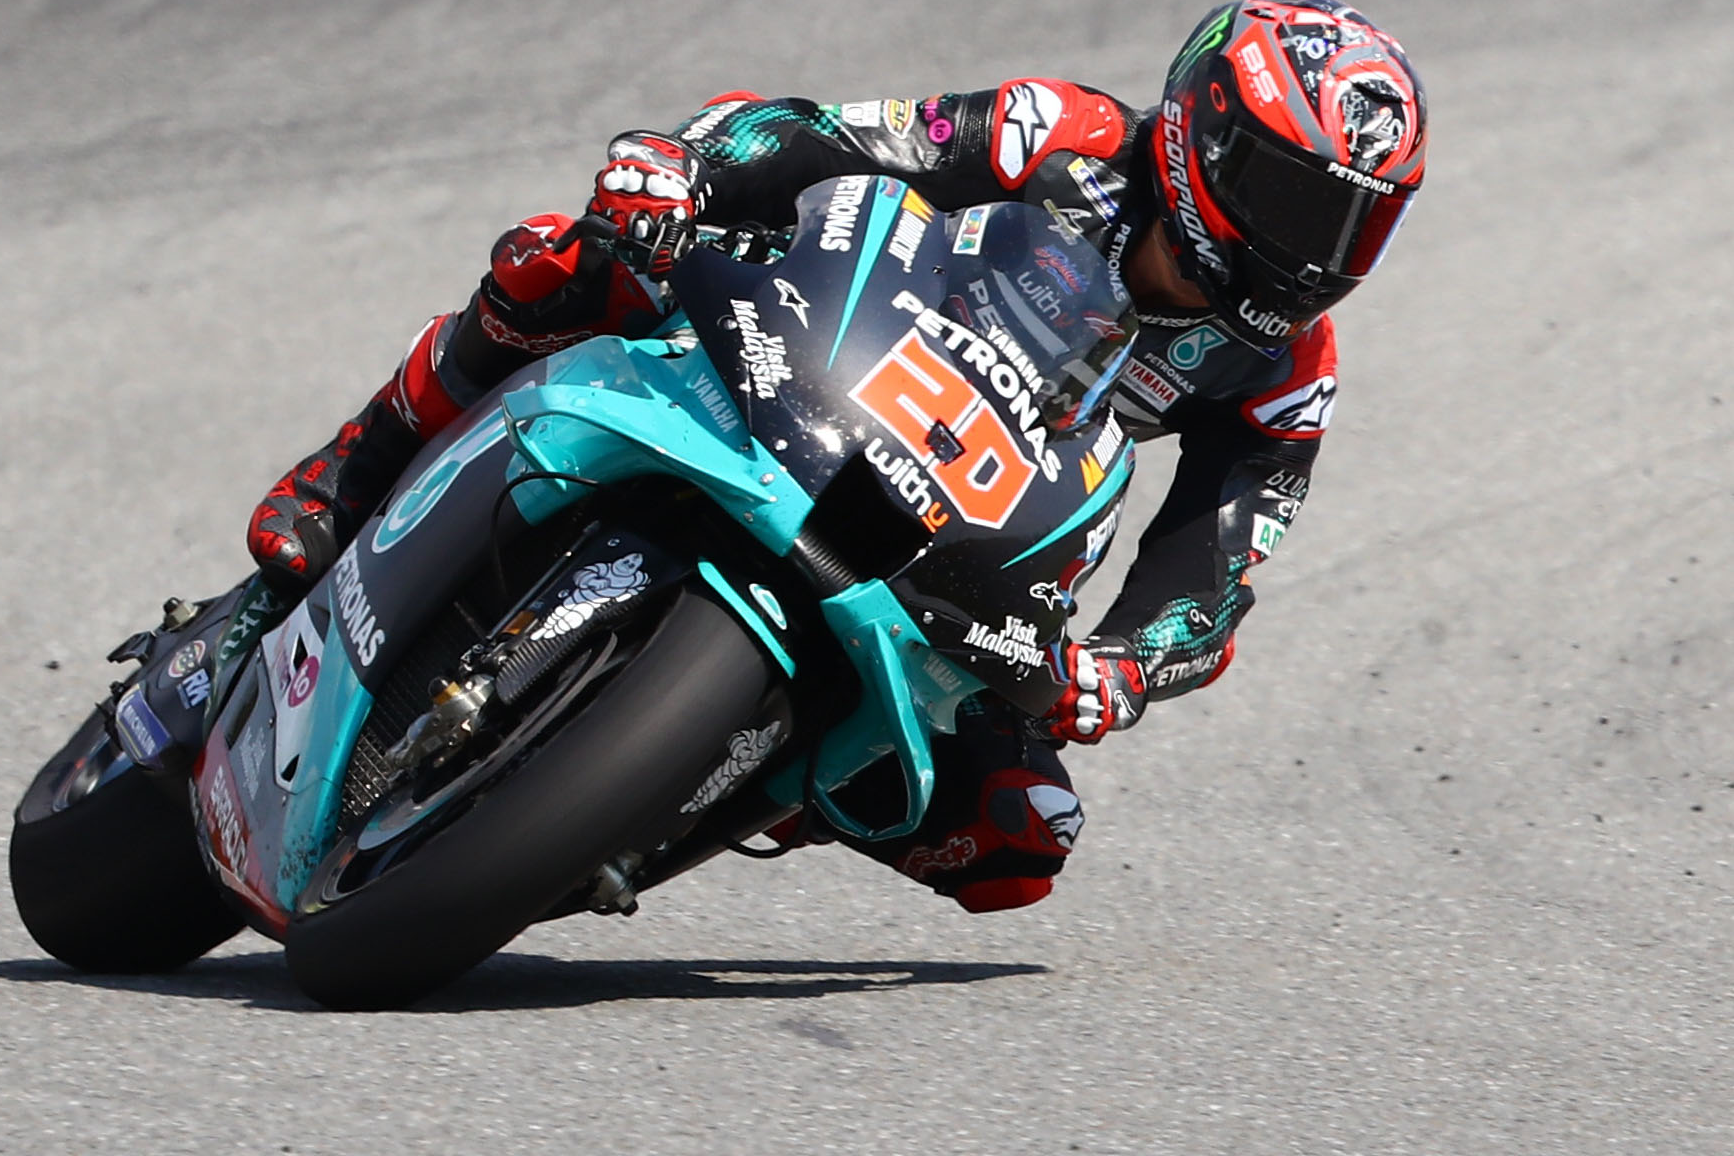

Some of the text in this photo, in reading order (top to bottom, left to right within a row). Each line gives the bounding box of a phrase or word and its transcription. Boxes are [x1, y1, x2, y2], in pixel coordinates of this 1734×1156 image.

[1162, 99, 1223, 265] SCORPION
[1327, 162, 1395, 195] PETRONAS
[1106, 223, 1132, 303] PETRONAS
[730, 299, 778, 401] Malaysia
[763, 333, 793, 385] Visit
[986, 325, 1044, 395] YAMAHA
[1144, 352, 1197, 395] PETRONAS
[695, 373, 741, 434] YAMAHA
[892, 290, 1063, 484] PETRONAS
[1127, 361, 1178, 403] YAMAHA
[847, 328, 1039, 530] 20
[963, 621, 1046, 669] Malaysia
[1004, 614, 1039, 644] Visit
